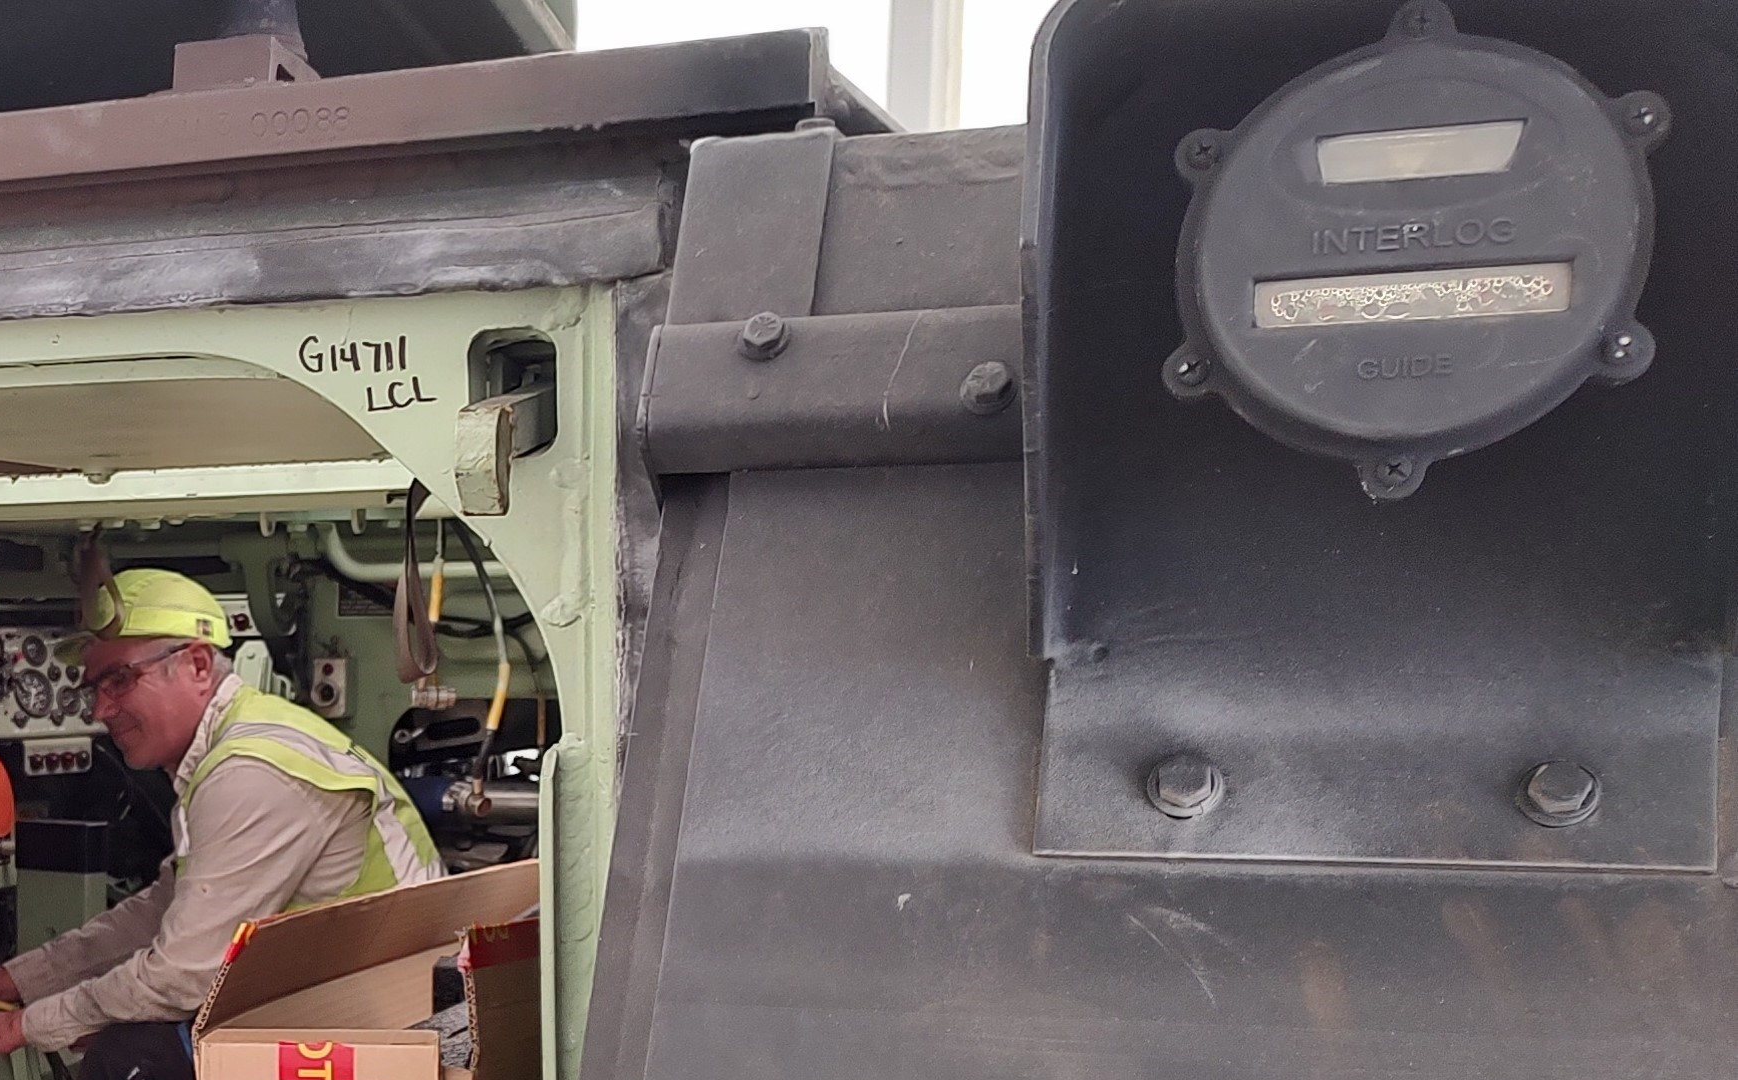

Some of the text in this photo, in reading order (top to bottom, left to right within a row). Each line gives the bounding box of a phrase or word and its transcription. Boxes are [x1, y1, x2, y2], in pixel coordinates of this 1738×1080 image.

[250, 106, 351, 138] 00088
[1312, 218, 1517, 255] INTERLOG
[298, 335, 408, 374] G14711
[1357, 352, 1454, 380] GUIDE
[367, 375, 438, 413] LCL
